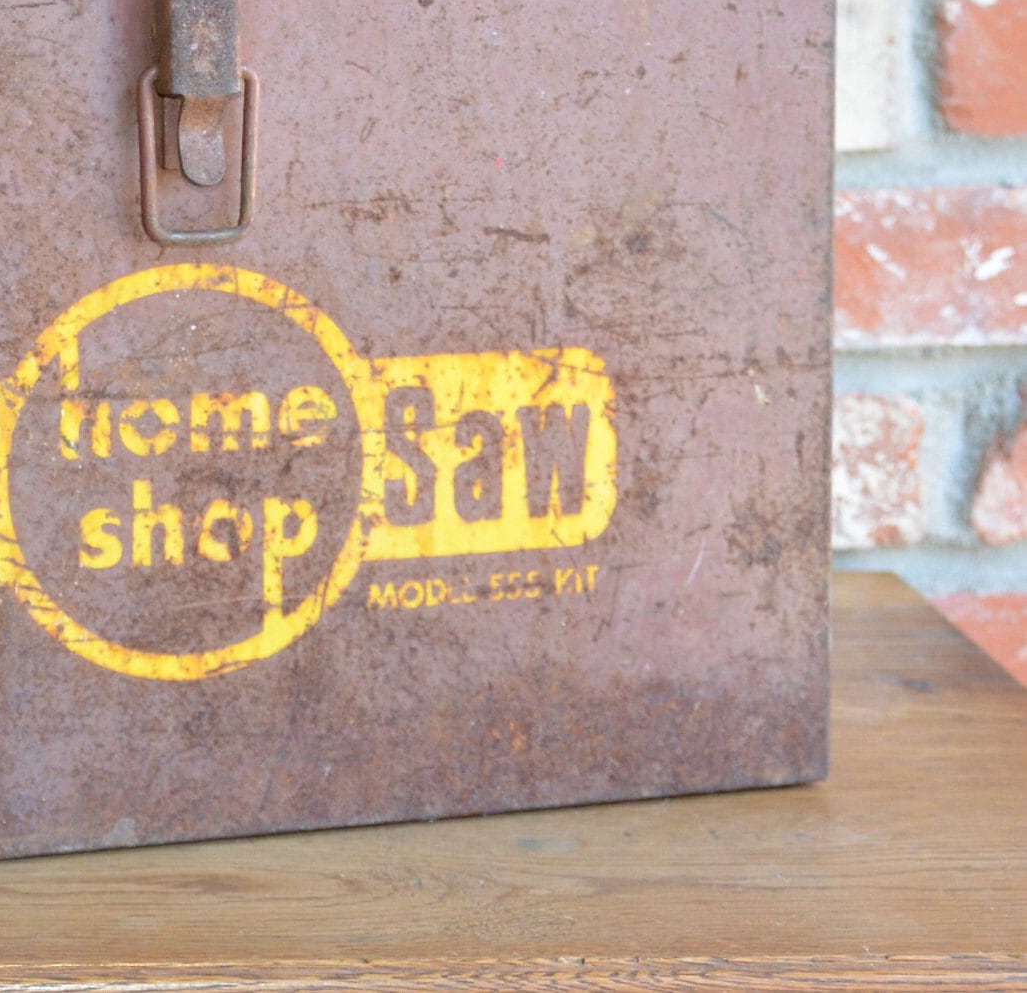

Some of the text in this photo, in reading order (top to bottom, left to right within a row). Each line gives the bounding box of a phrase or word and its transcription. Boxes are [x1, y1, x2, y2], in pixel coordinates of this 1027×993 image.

[59, 331, 338, 460] home
[384, 385, 591, 527] Saw
[78, 479, 319, 618] shop
[554, 564, 601, 596] KIT
